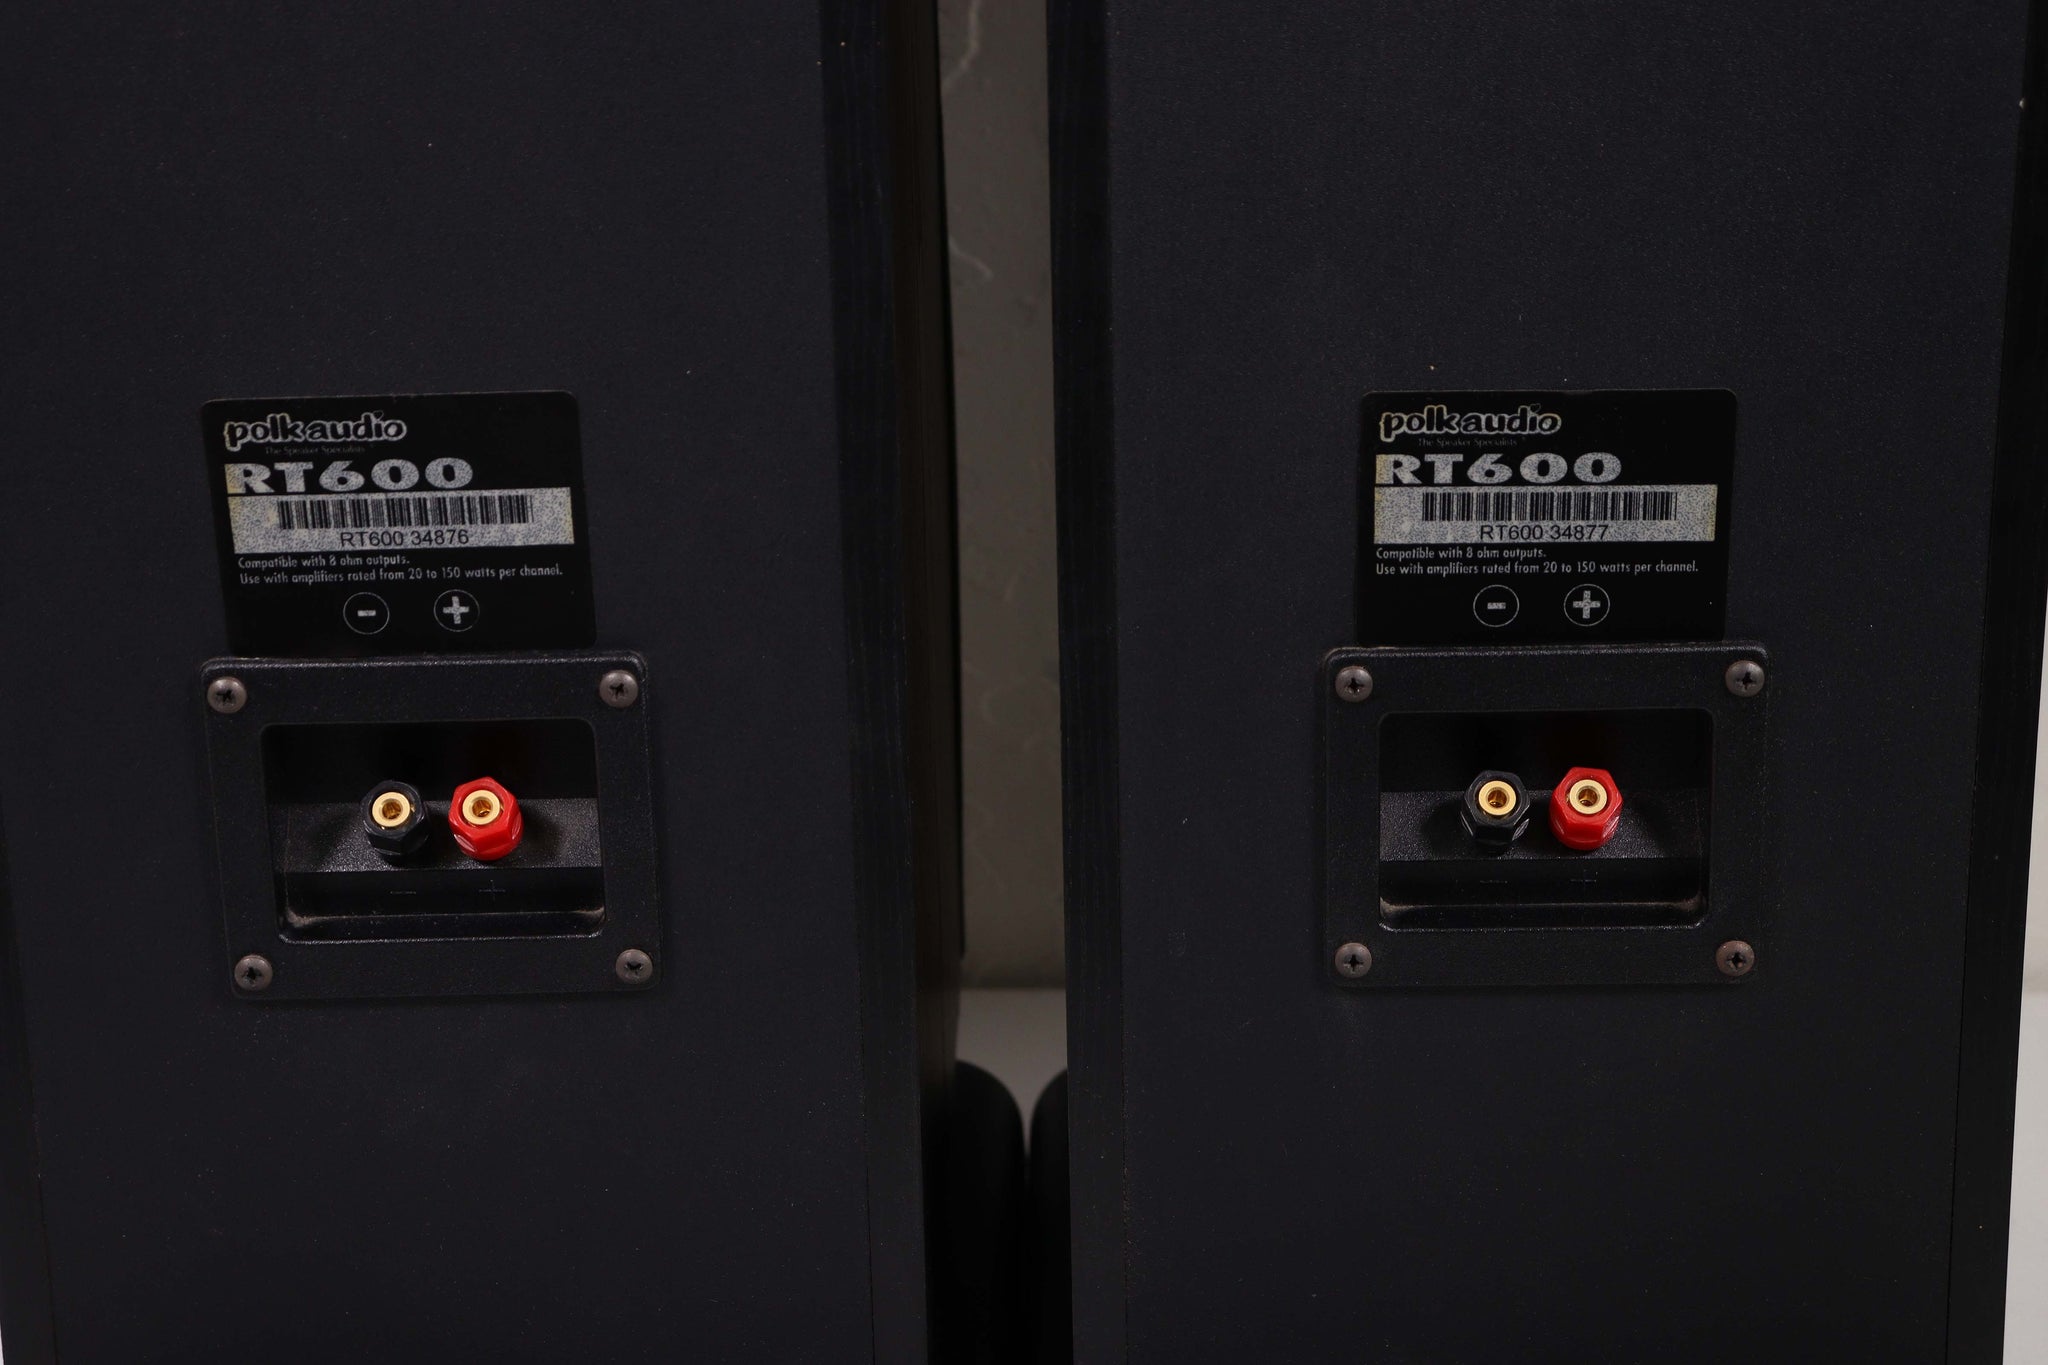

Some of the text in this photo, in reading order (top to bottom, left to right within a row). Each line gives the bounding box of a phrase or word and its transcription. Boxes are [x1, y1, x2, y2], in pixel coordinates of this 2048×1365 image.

[224, 456, 474, 495] RT600
[1374, 451, 1622, 485] RT600
[340, 529, 470, 548] RT600 34876
[1480, 524, 1609, 541] RT600 34877
[238, 554, 410, 571] Compatible with 8 ohm outputs.
[1376, 546, 1547, 562] Compatible with 8 ohm outputs.
[239, 562, 563, 586] Use with amplifiers rated from 20 to 150 watts per channel.
[1376, 560, 1699, 578] Use with amplifiers rated from 20 to 150 watts per channel.
